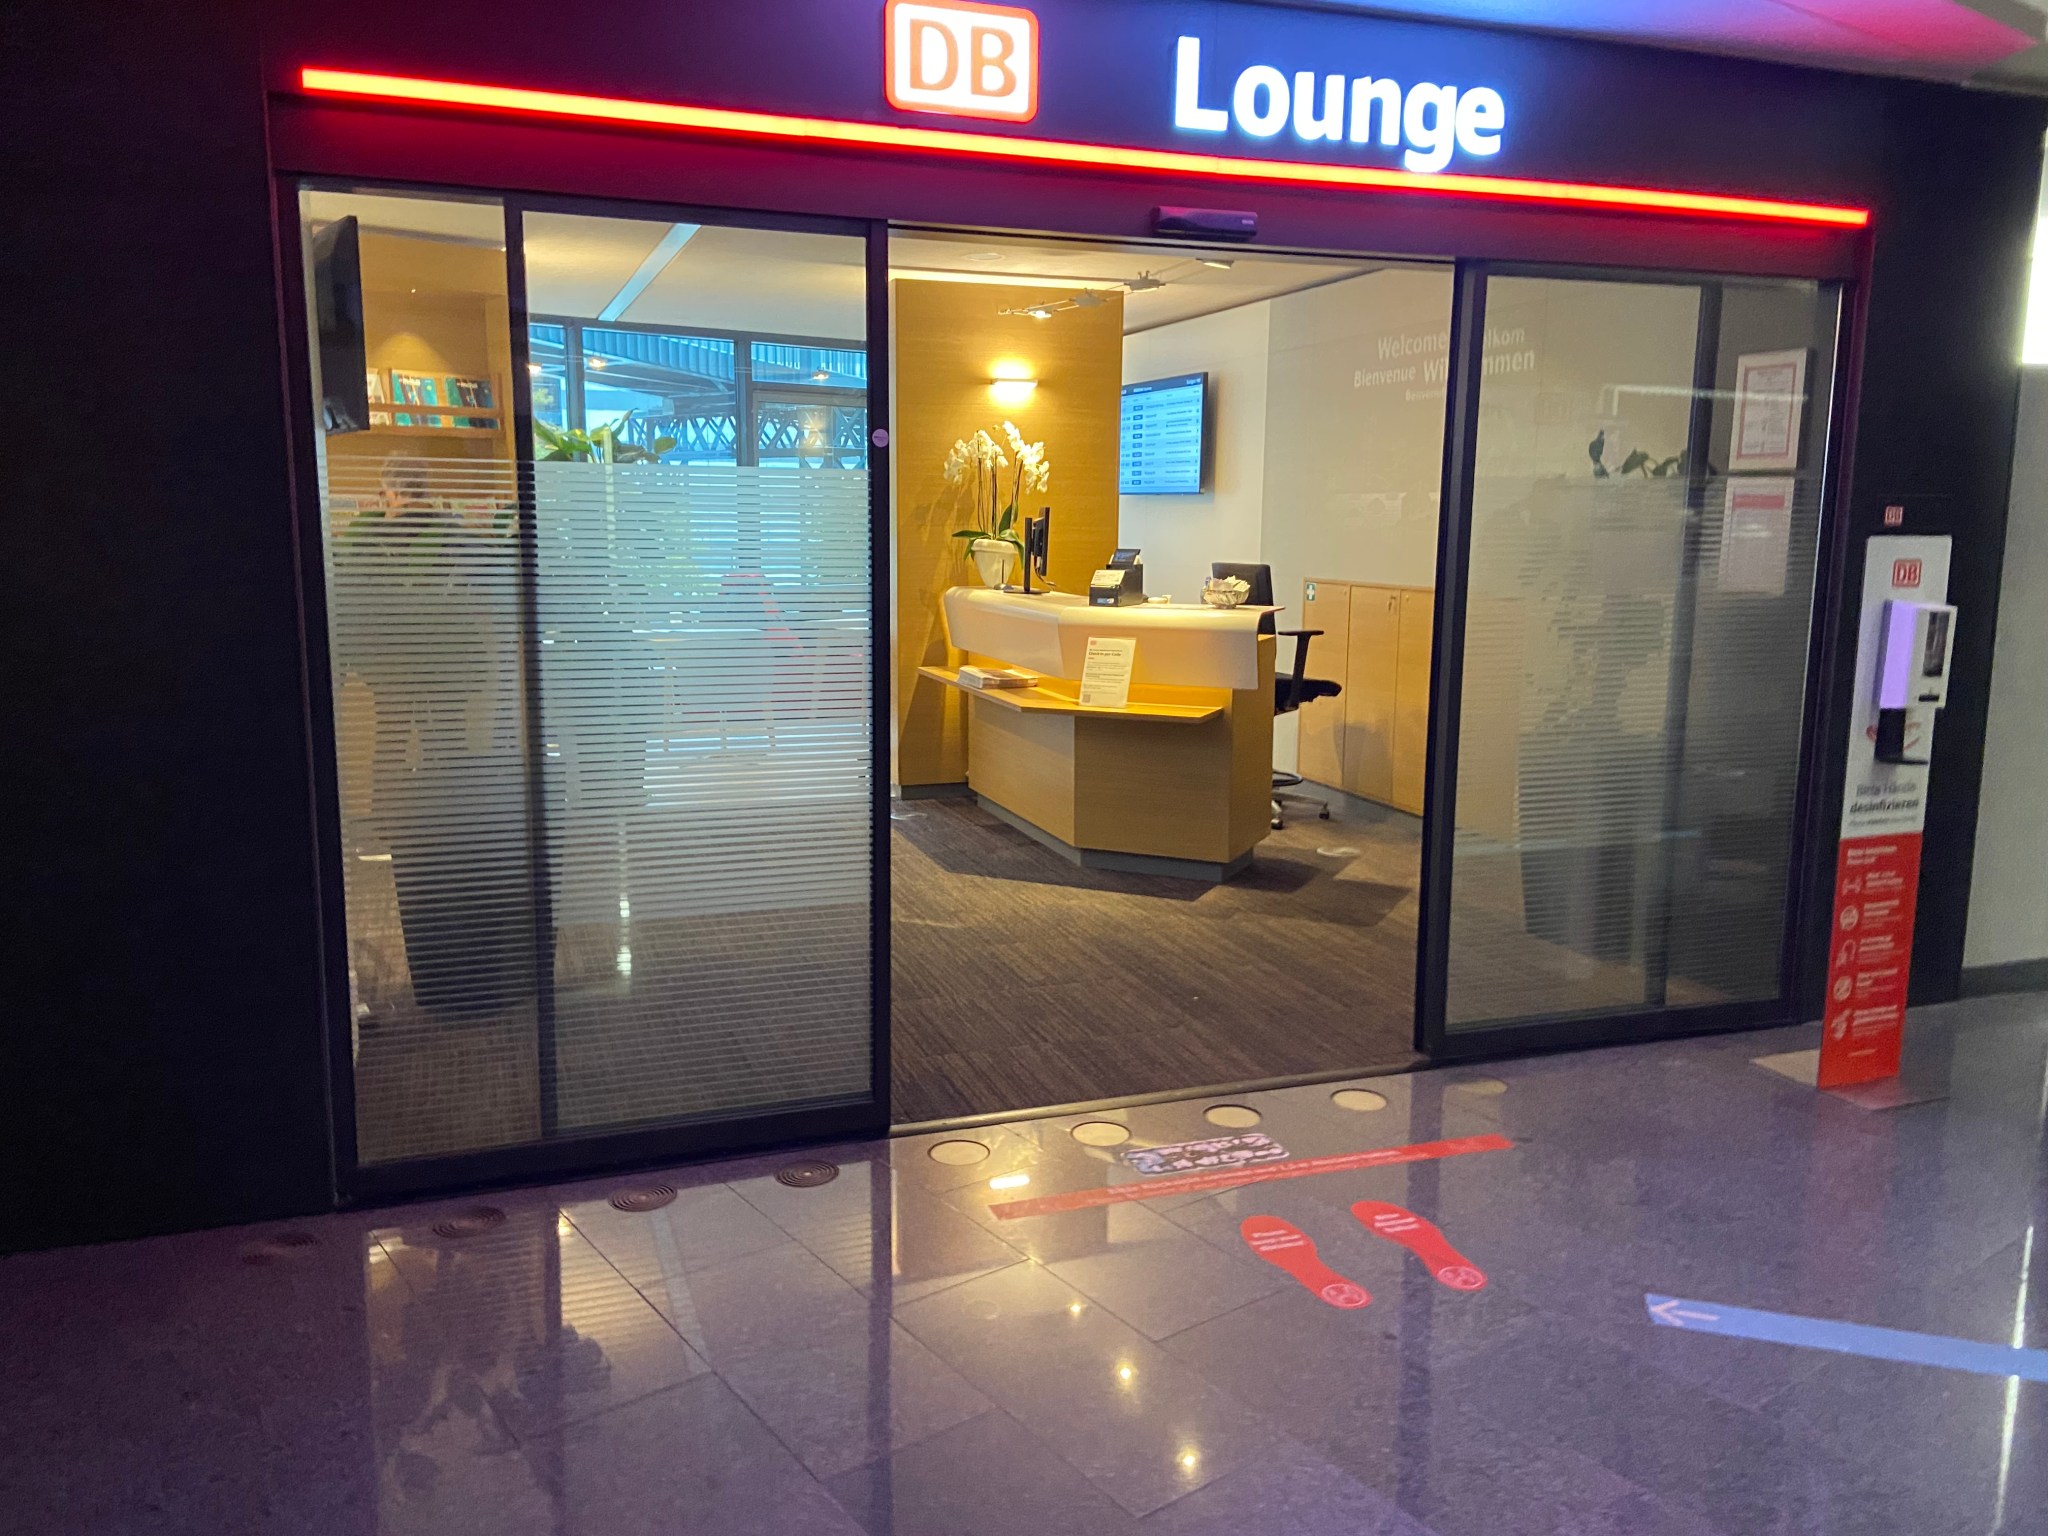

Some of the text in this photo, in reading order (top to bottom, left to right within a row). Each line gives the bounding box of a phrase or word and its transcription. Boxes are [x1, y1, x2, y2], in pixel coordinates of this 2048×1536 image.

[908, 19, 1018, 98] DB
[1173, 35, 1506, 173] Lounge
[1377, 333, 1448, 361] Welcome
[1353, 366, 1417, 388] Bienvenue
[1896, 563, 1919, 583] DB
[1849, 799, 1920, 813] desinfizieren
